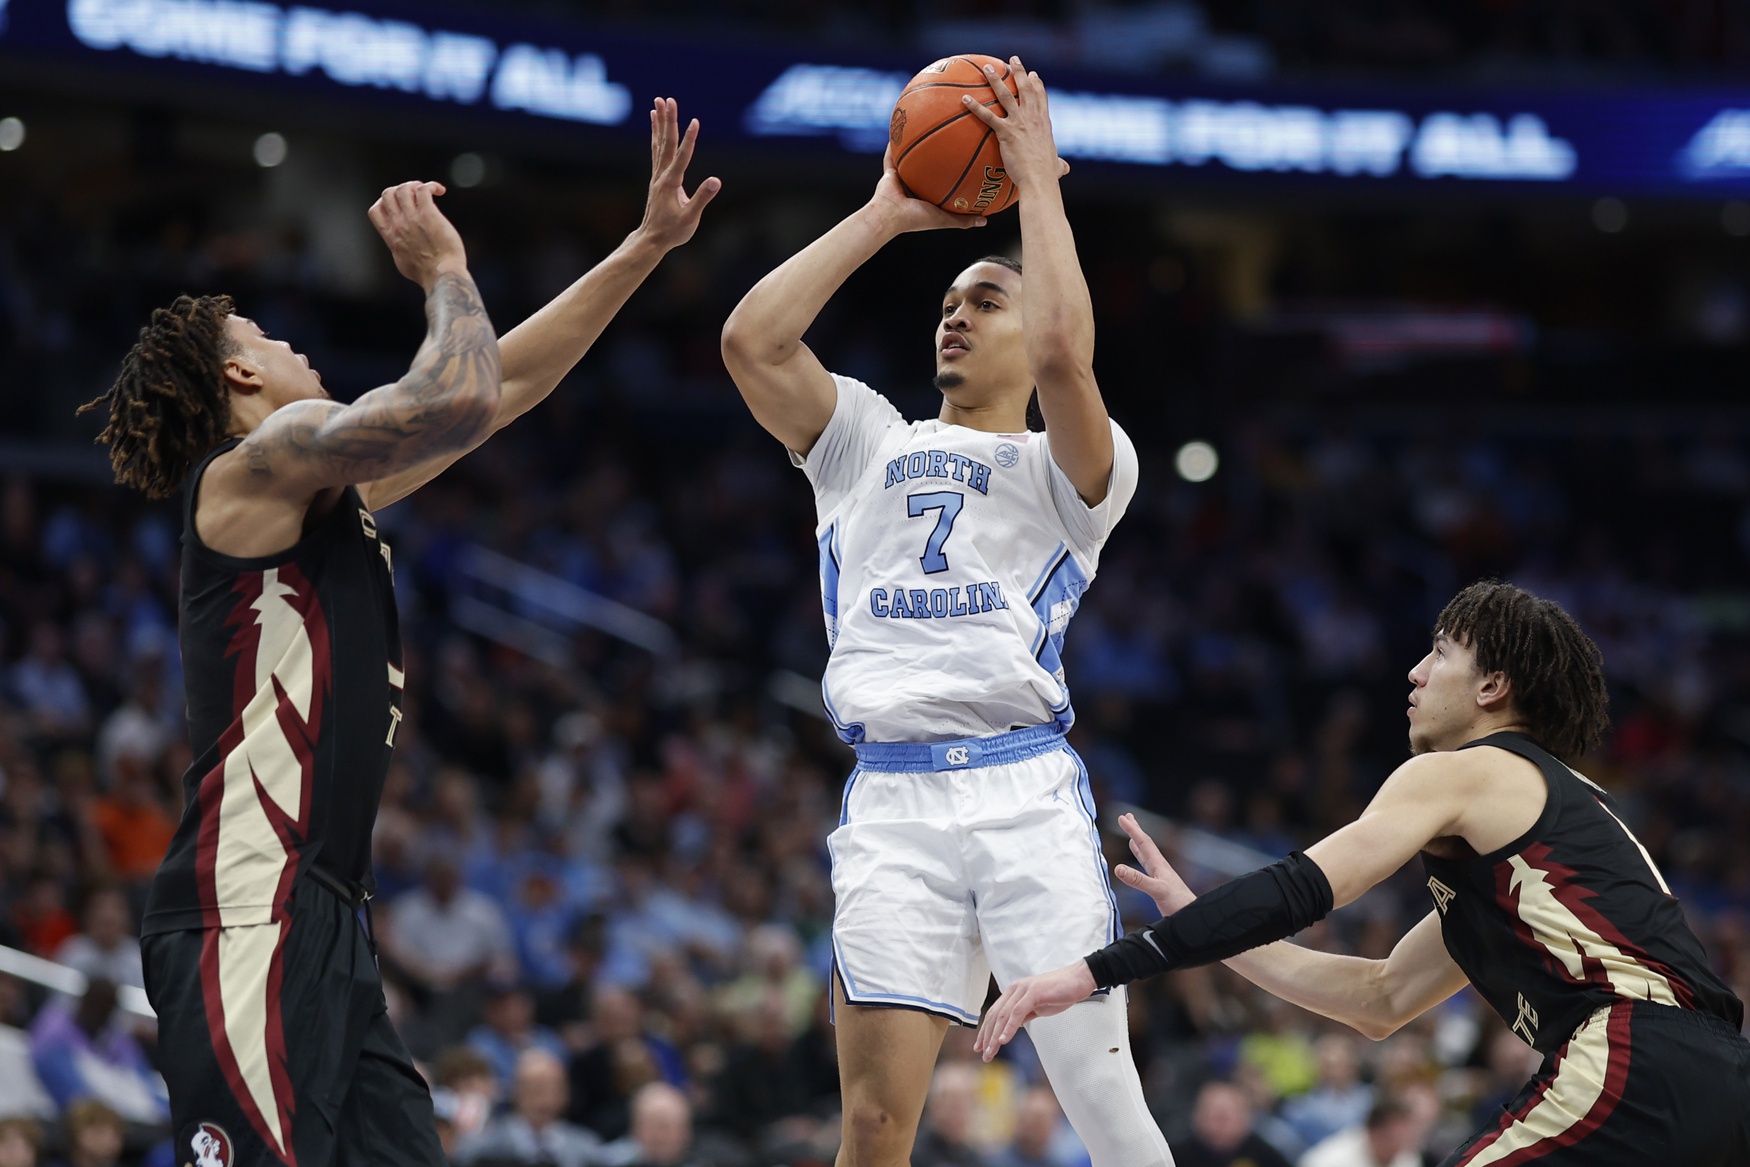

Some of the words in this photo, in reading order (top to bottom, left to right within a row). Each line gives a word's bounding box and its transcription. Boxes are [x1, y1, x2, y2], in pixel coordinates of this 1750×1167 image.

[493, 43, 633, 126] ALL
[1408, 111, 1578, 181] ALL
[885, 450, 992, 496] NORTH
[907, 491, 964, 575] 7
